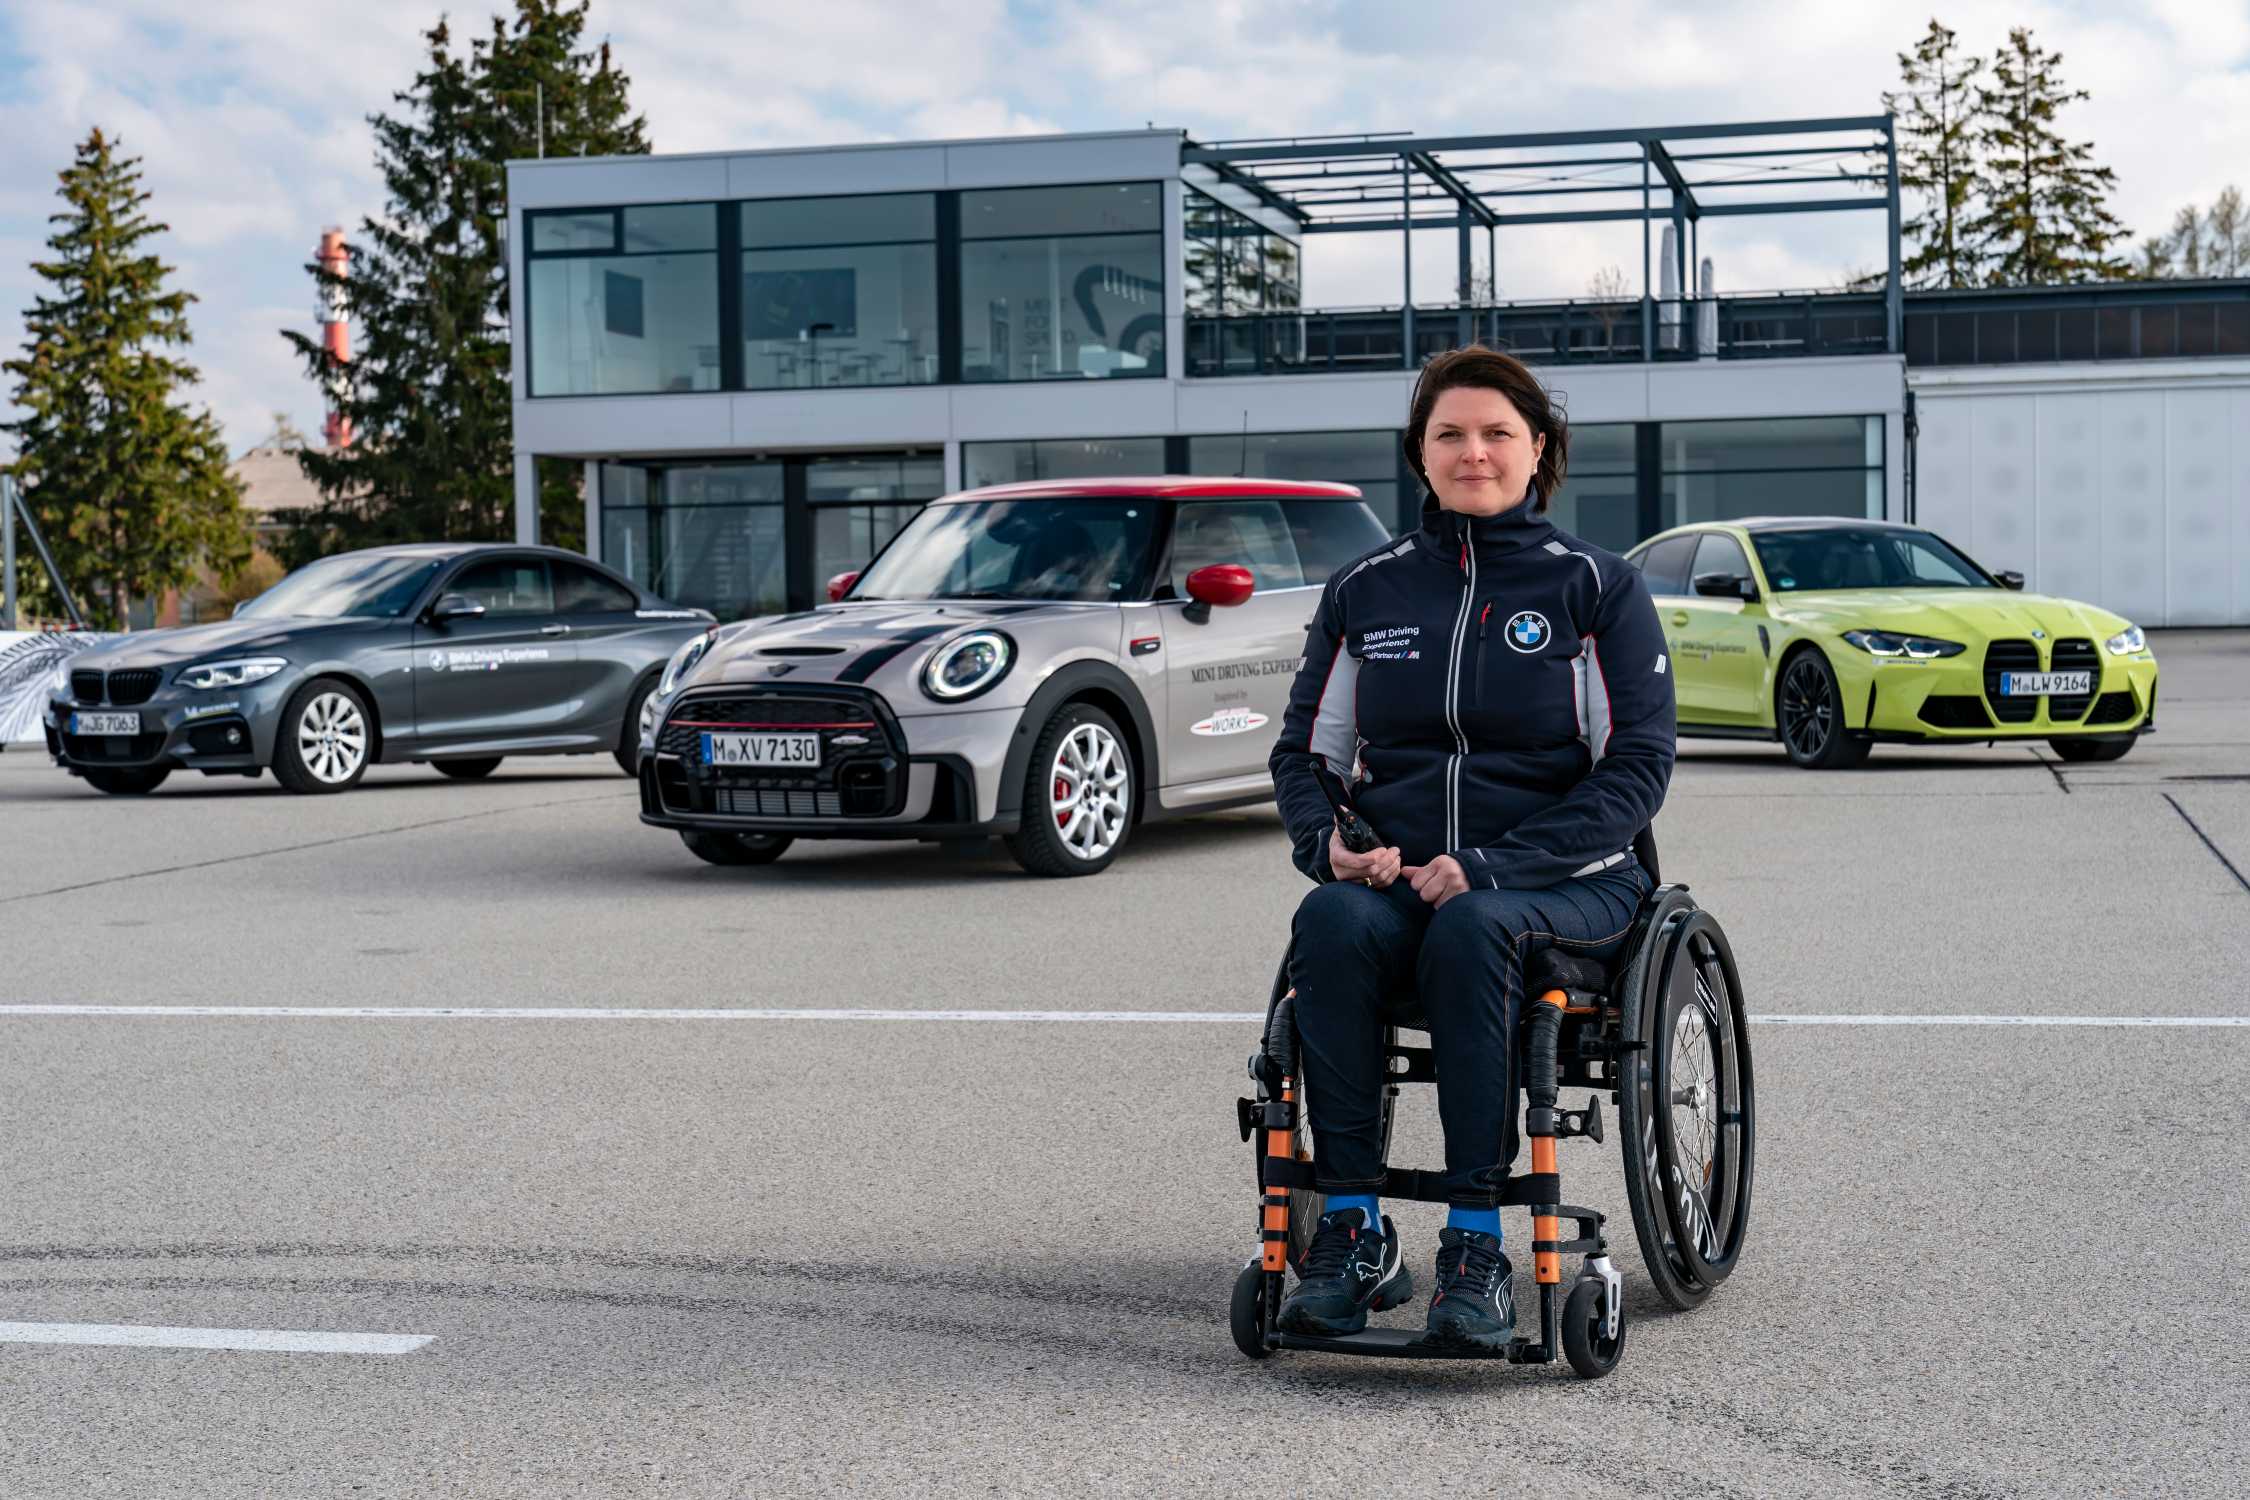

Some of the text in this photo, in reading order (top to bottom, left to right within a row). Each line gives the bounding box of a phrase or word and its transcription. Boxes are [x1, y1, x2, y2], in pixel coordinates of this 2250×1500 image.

[1512, 615, 1547, 629] BMW
[1363, 626, 1420, 642] BMW Driving
[1362, 638, 1410, 650] Experience
[1191, 667, 1216, 683] MINI
[1218, 662, 1260, 680] DRIVING
[2011, 675, 2089, 692] M LW 9164
[106, 715, 137, 730] 7063
[1212, 716, 1249, 732] WORKS
[713, 738, 726, 761] M
[738, 738, 762, 761] XV
[767, 738, 816, 762] 7130
